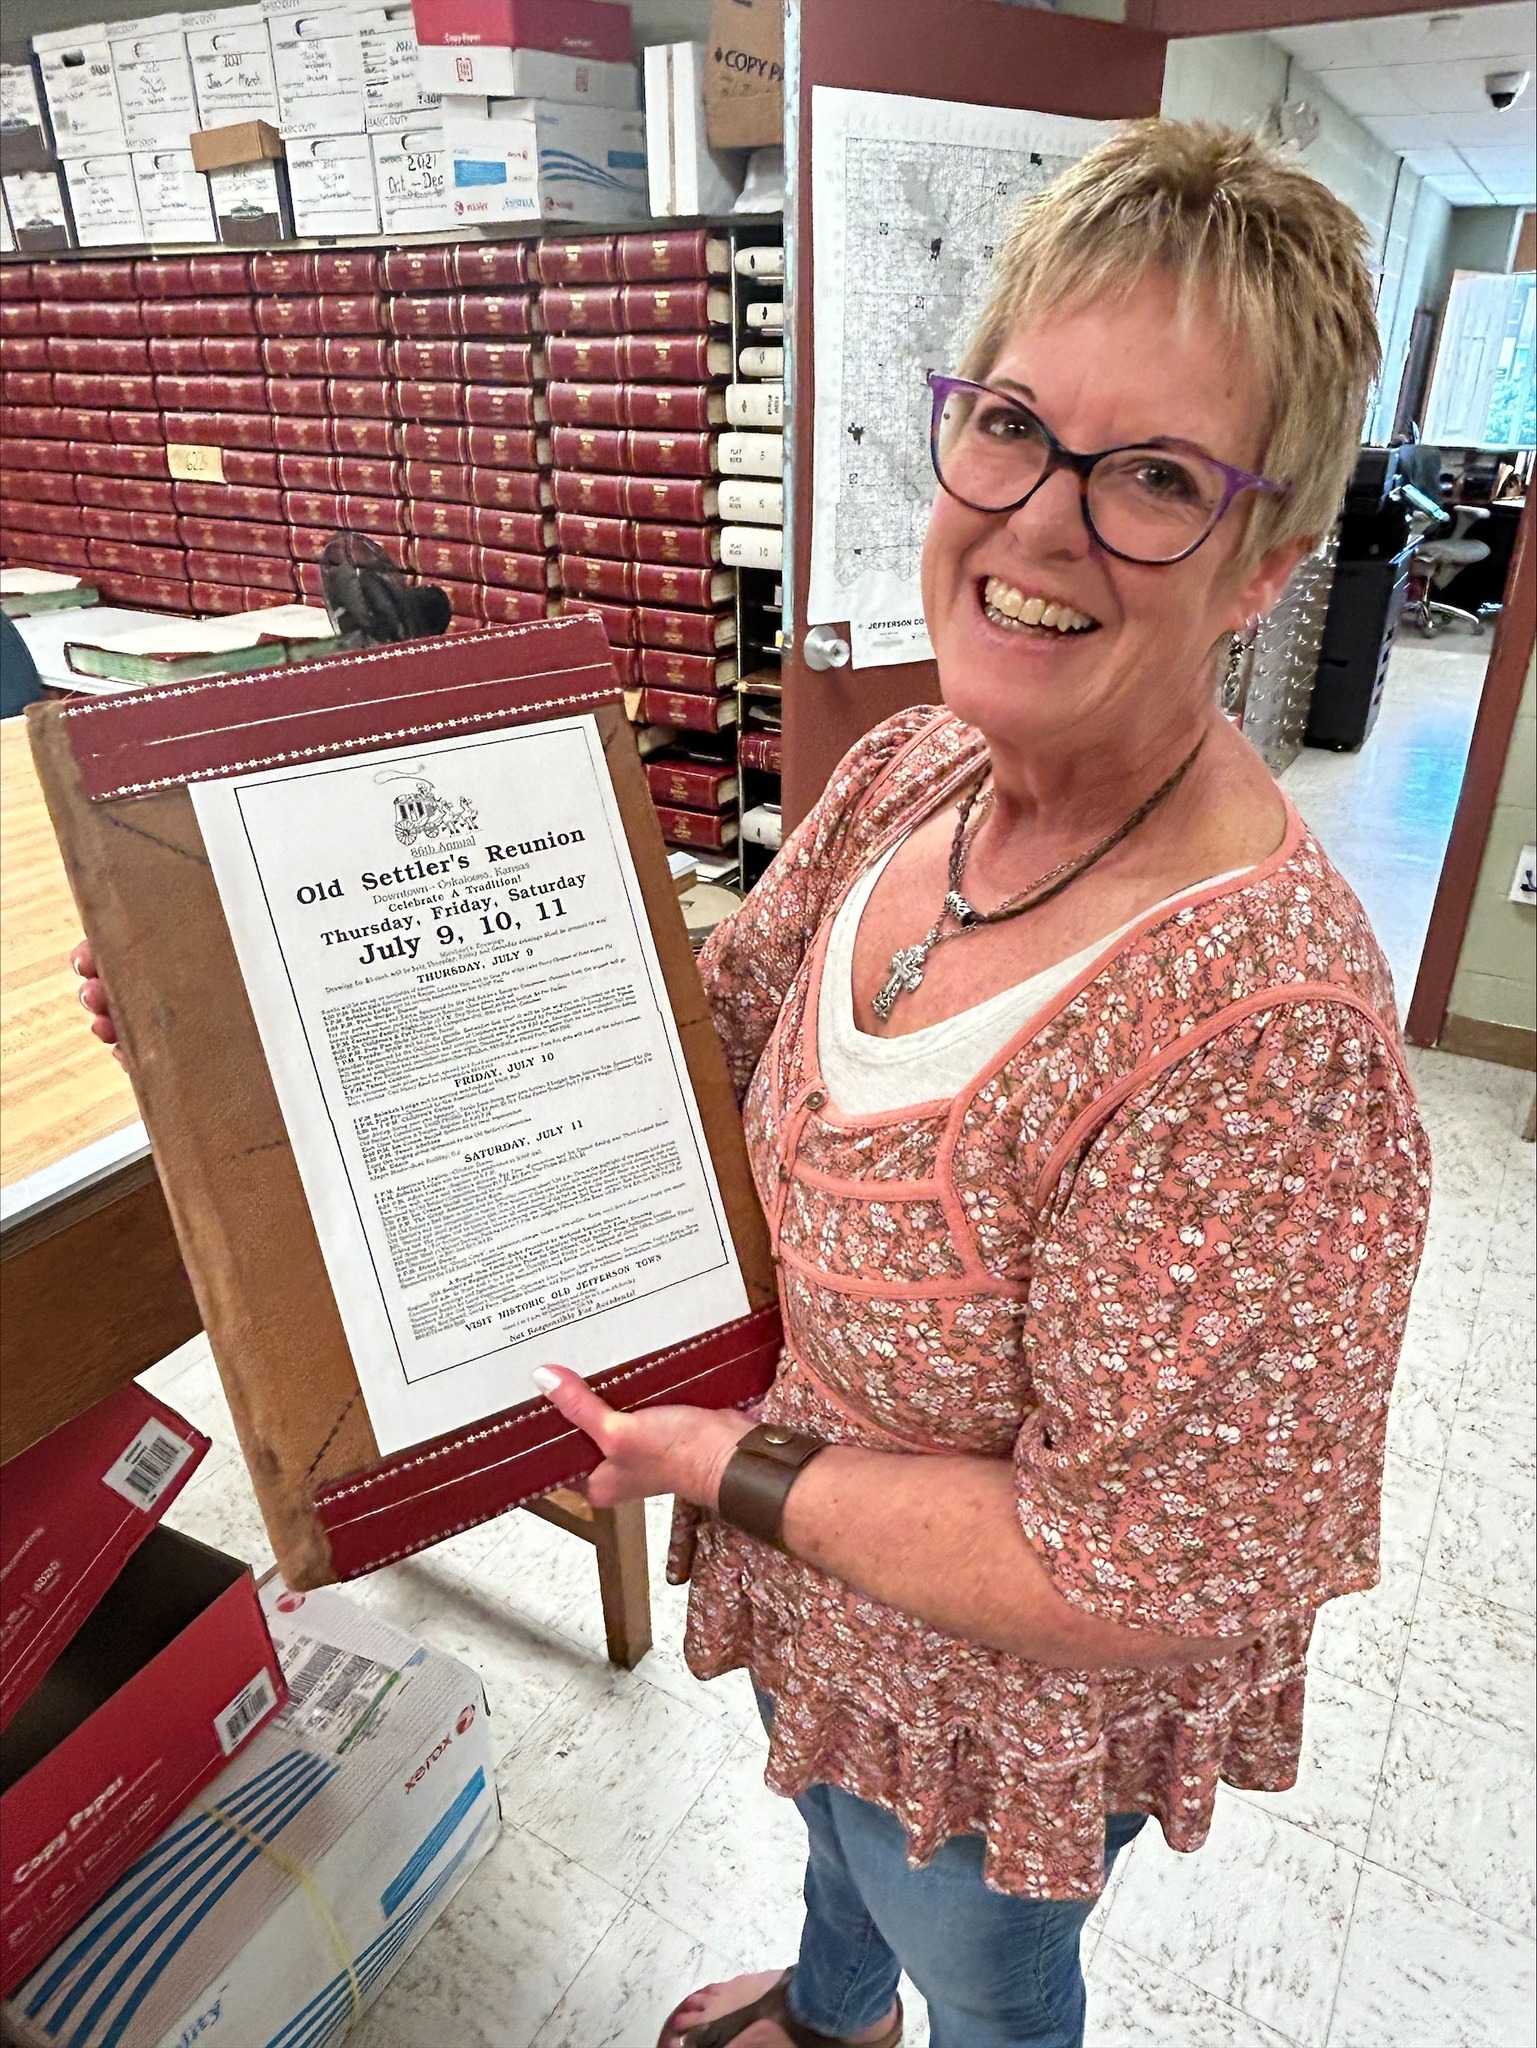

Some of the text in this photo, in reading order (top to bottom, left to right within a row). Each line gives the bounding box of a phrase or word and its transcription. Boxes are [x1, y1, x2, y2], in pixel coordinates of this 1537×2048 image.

[725, 49, 768, 77] COPY
[407, 153, 438, 173] 2021
[868, 619, 912, 630] JEFFERSON
[437, 834, 476, 853] Annual
[296, 829, 585, 904] Old Settler's Reunion
[493, 861, 530, 876] Kansas
[319, 873, 586, 946] Thursday, Friday, Saturday
[387, 873, 521, 912] Celebrate A Tradition!
[358, 897, 567, 964] July 9, 10, 11
[416, 947, 533, 983] THURSDAY, JULY 9
[453, 1051, 554, 1087] FRIDAY, JULY 10
[463, 1119, 583, 1163] SATURDAY, JULY 11
[464, 1254, 661, 1331] VISIT HISTORIC OLD JEFFERSON TOWN
[509, 1331, 525, 1342] Not
[403, 1738, 451, 1794] xerox
[13, 1776, 125, 1885] Copy Paper
